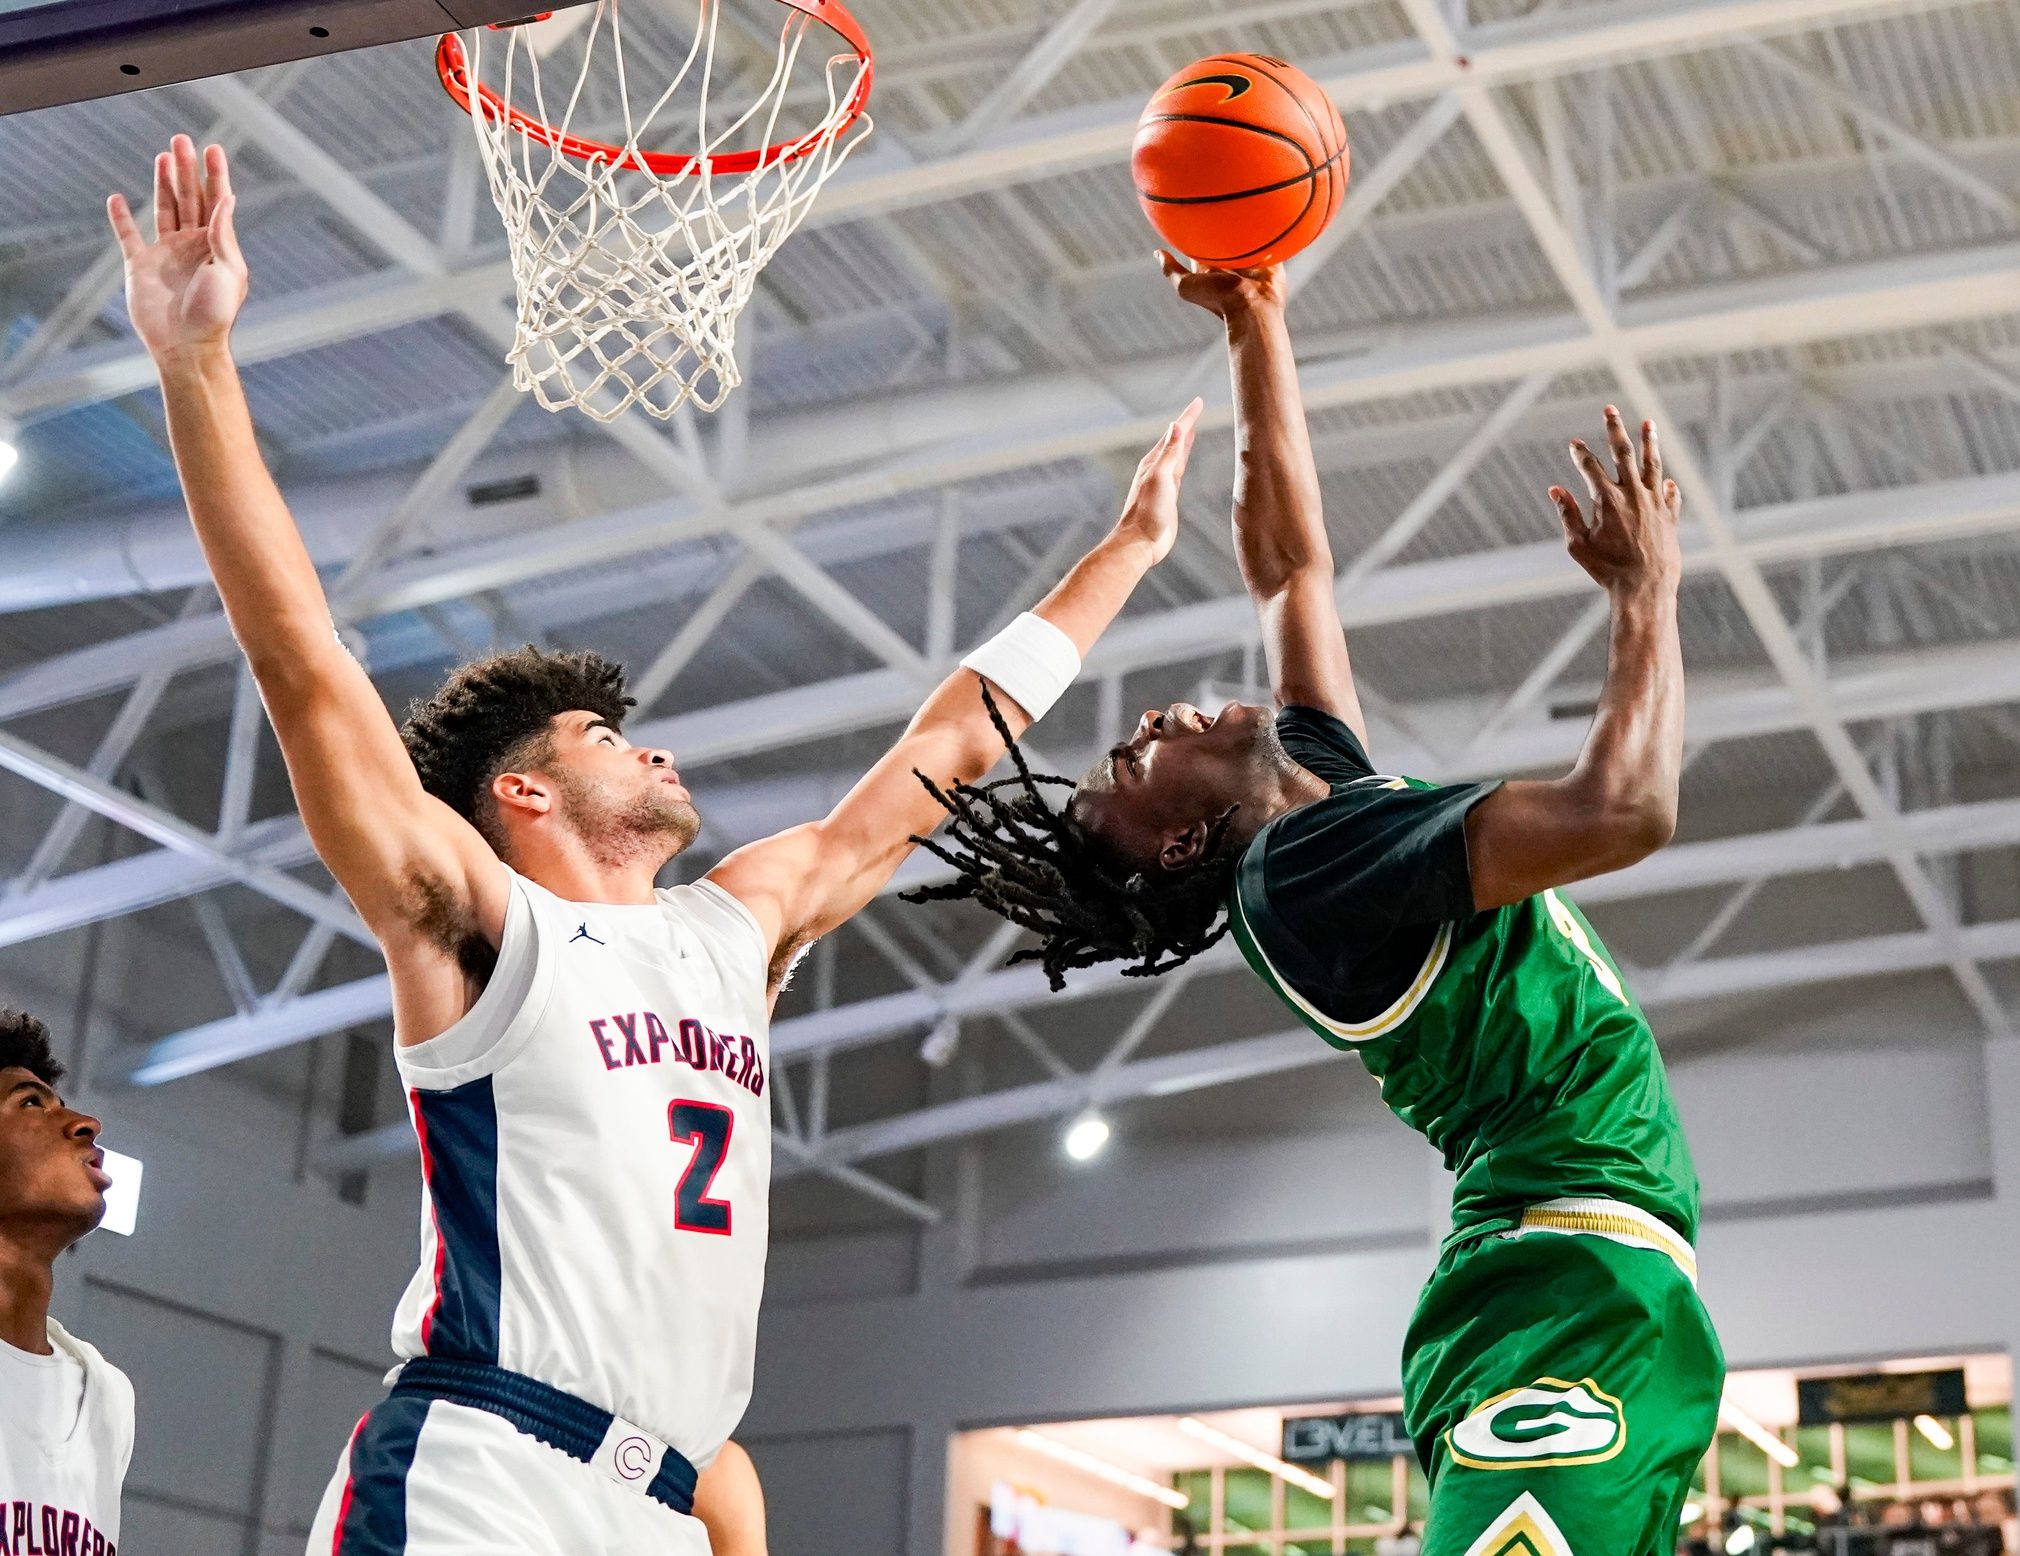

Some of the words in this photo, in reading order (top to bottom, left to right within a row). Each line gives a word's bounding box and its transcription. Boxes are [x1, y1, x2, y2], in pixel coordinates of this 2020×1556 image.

[667, 1098, 735, 1236] 2
[614, 1436, 652, 1481] C
[1444, 1376, 1627, 1470] G
